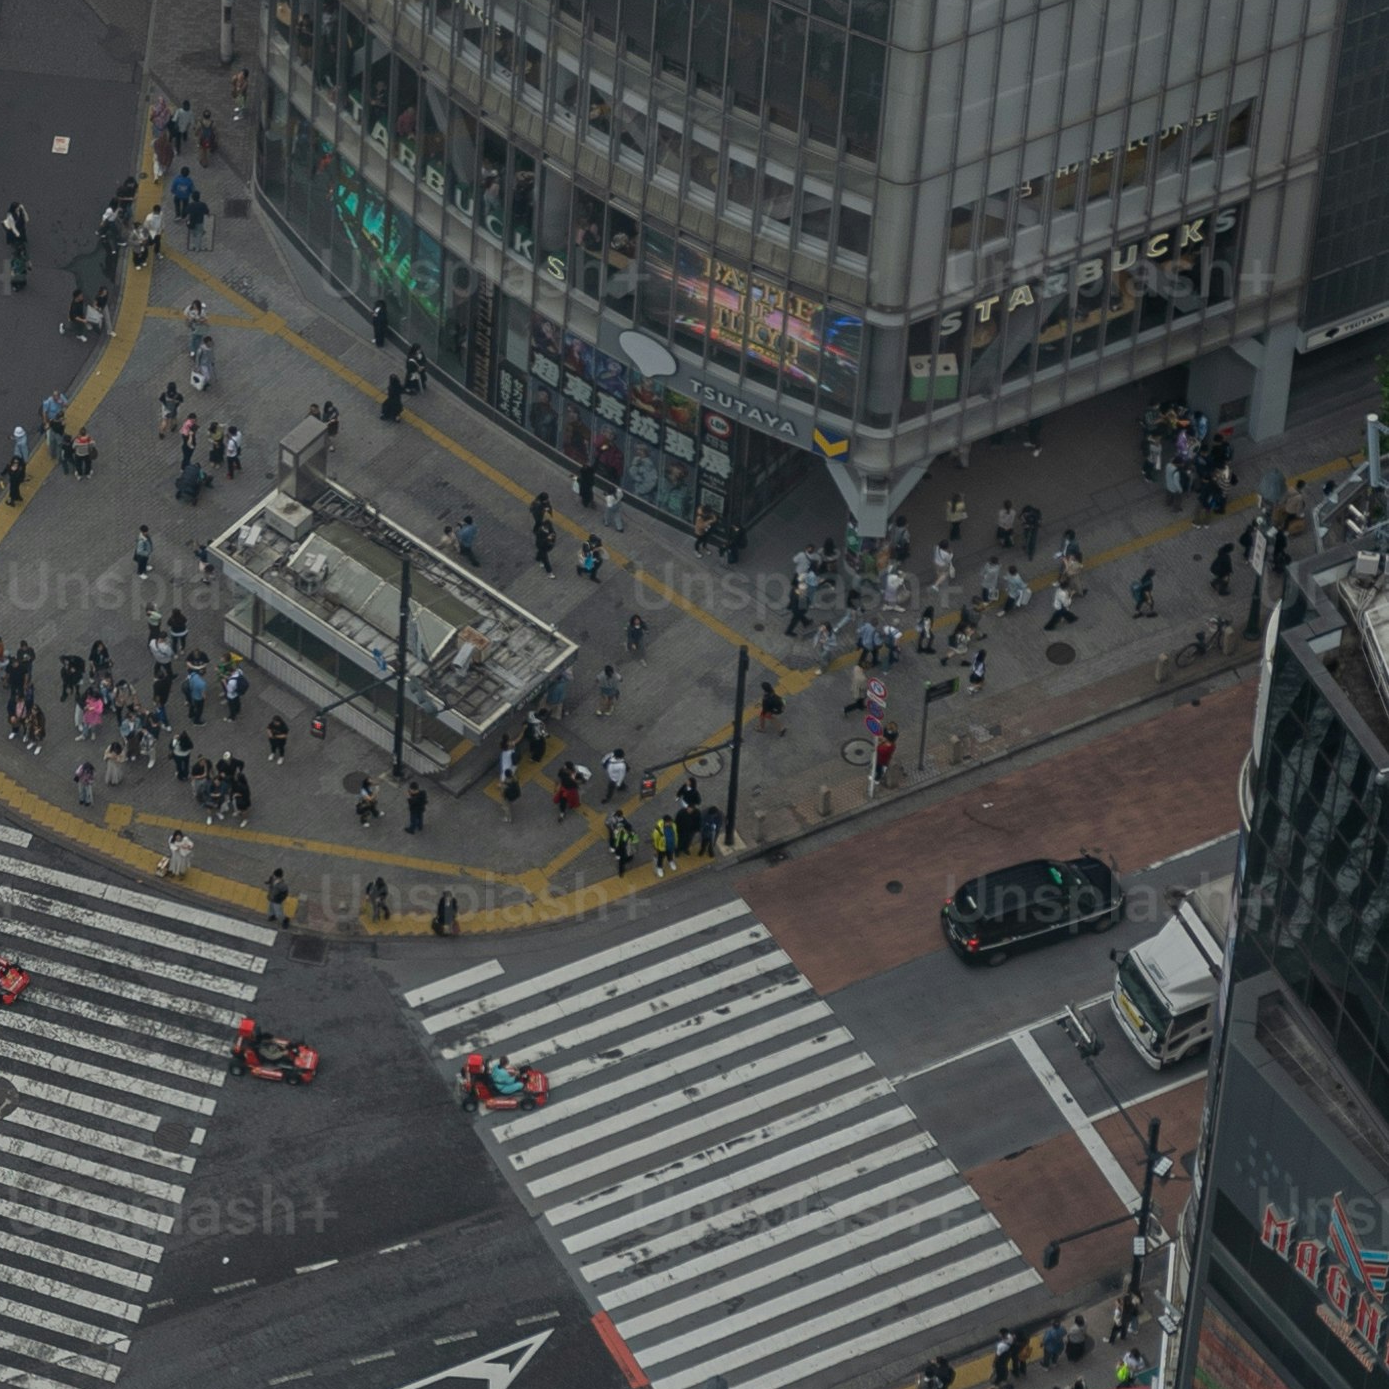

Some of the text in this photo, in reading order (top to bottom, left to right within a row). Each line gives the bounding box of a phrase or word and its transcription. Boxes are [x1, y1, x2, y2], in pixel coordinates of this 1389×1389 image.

[348, 94, 567, 280] TARBUCKS
[939, 207, 1237, 337] STARBUCKS
[690, 378, 798, 437] TSUTAYA
[1261, 1202, 1389, 1368] MAGN
